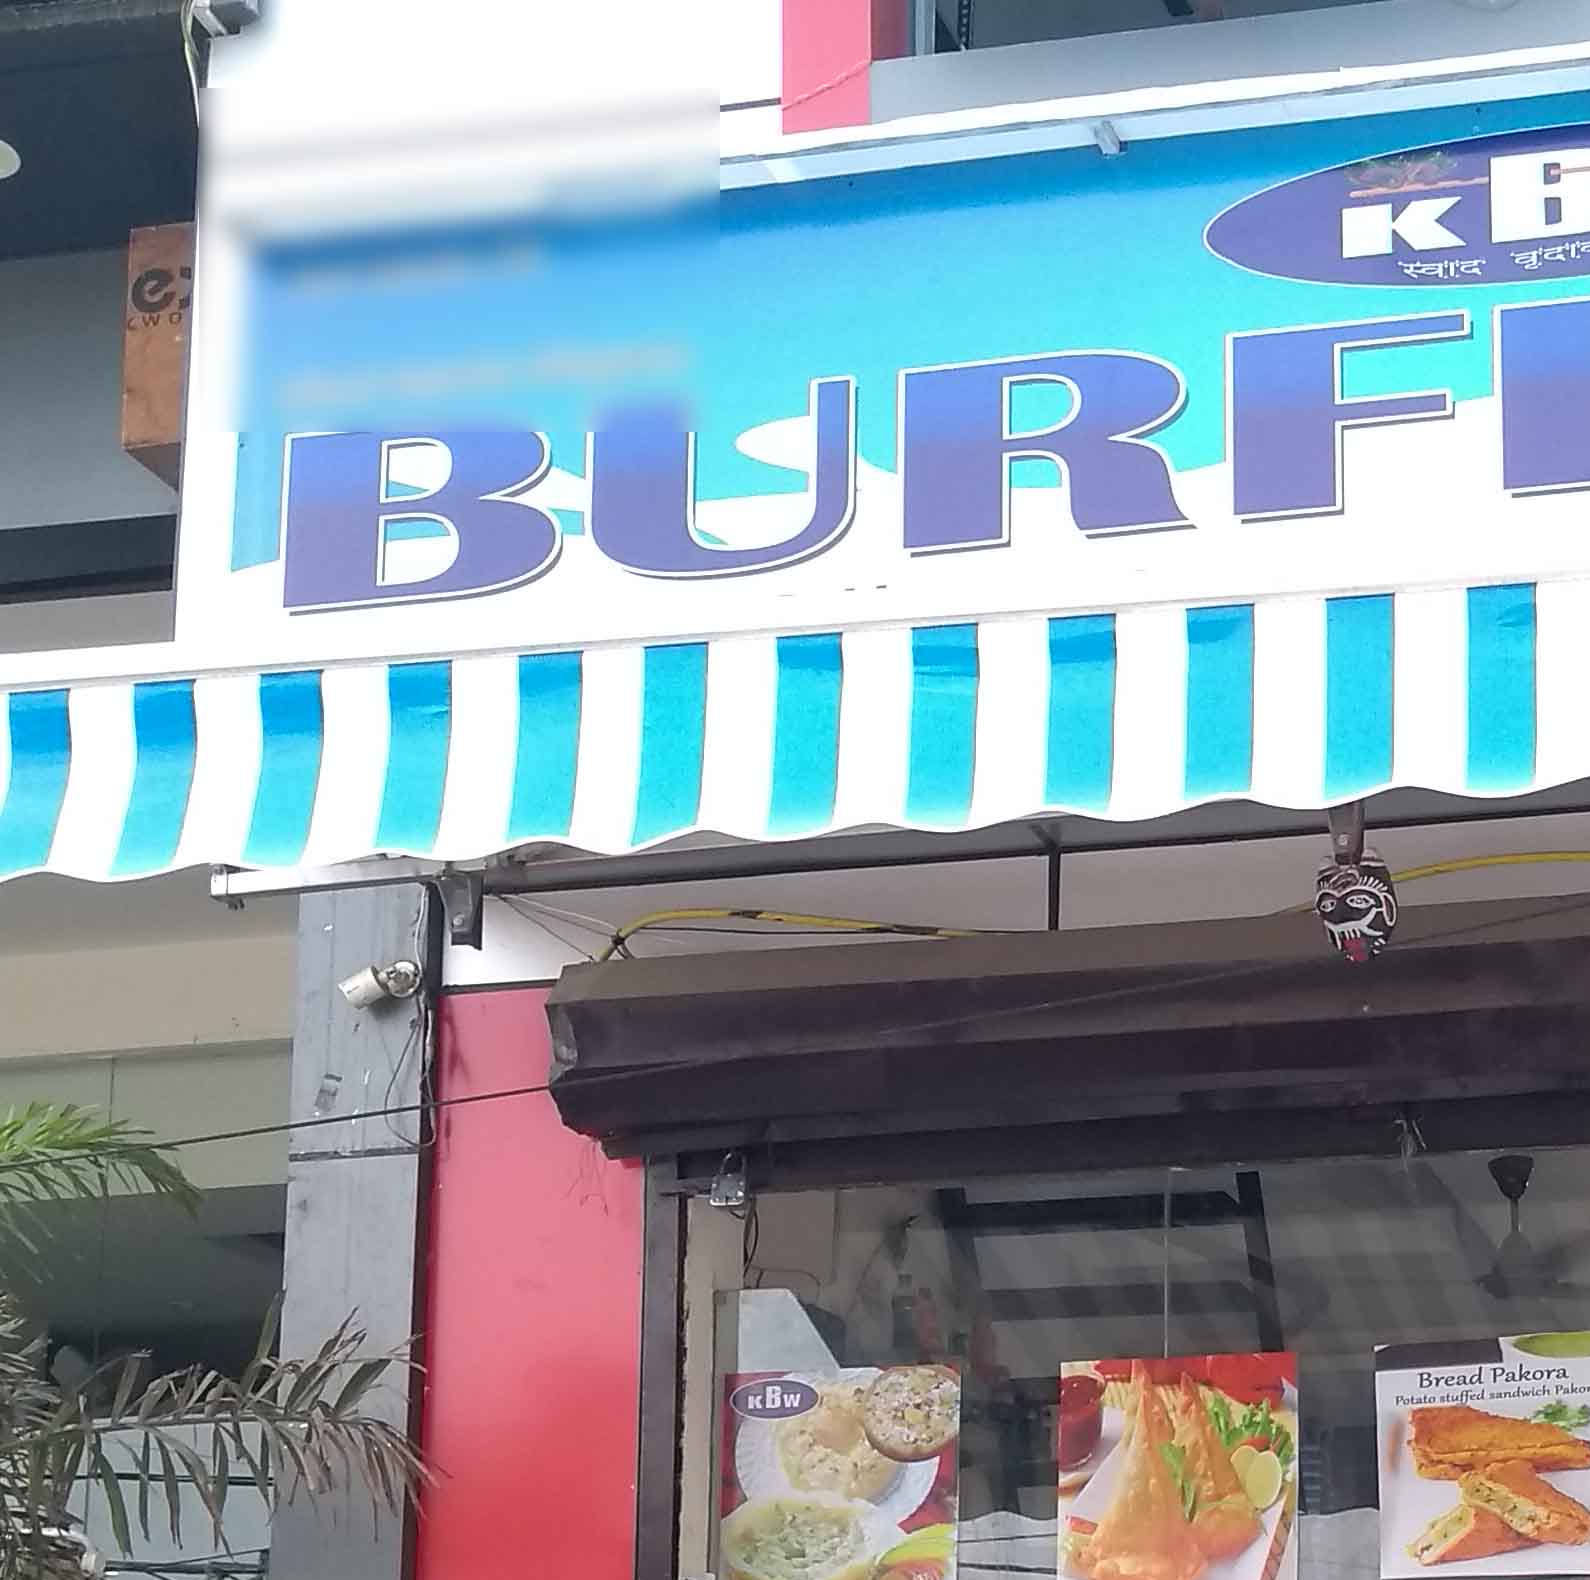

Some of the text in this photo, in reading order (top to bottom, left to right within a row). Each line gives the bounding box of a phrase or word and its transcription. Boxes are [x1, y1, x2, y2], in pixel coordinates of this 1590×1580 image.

[1417, 1363, 1570, 1389] Bread Pakora
[747, 1385, 801, 1409] KBW
[1395, 1394, 1437, 1406] Potato
[1439, 1388, 1485, 1406] stuffed
[1488, 1384, 1551, 1400] sandwich
